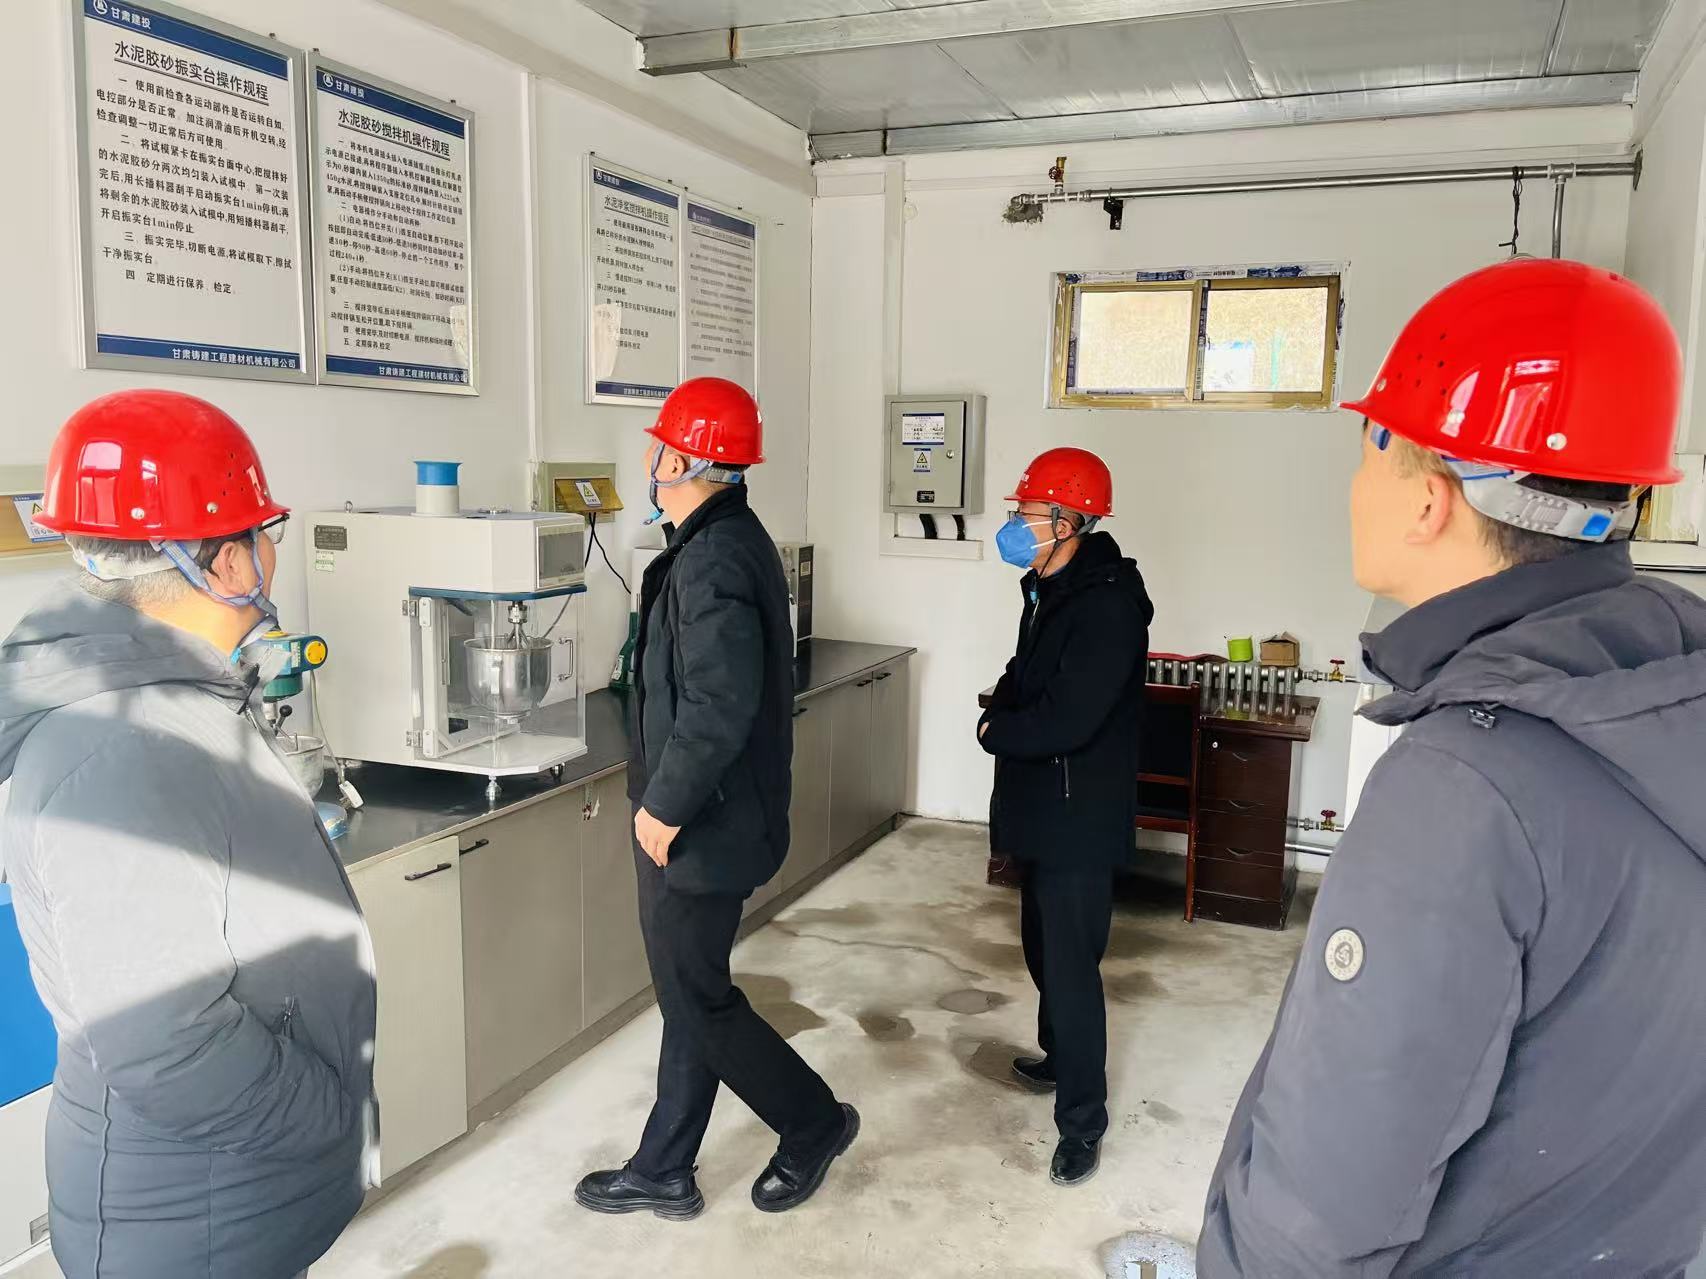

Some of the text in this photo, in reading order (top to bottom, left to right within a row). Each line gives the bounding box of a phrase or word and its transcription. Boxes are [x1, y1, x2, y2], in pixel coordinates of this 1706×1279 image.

[111, 7, 151, 30] 甘肃建投
[114, 41, 269, 101] 水泥胶砂振实台操作规程
[338, 108, 450, 156] 水泥胶砂搅拌机操作规程
[172, 348, 296, 369] 甘肃铸建工程建材机械有限公司
